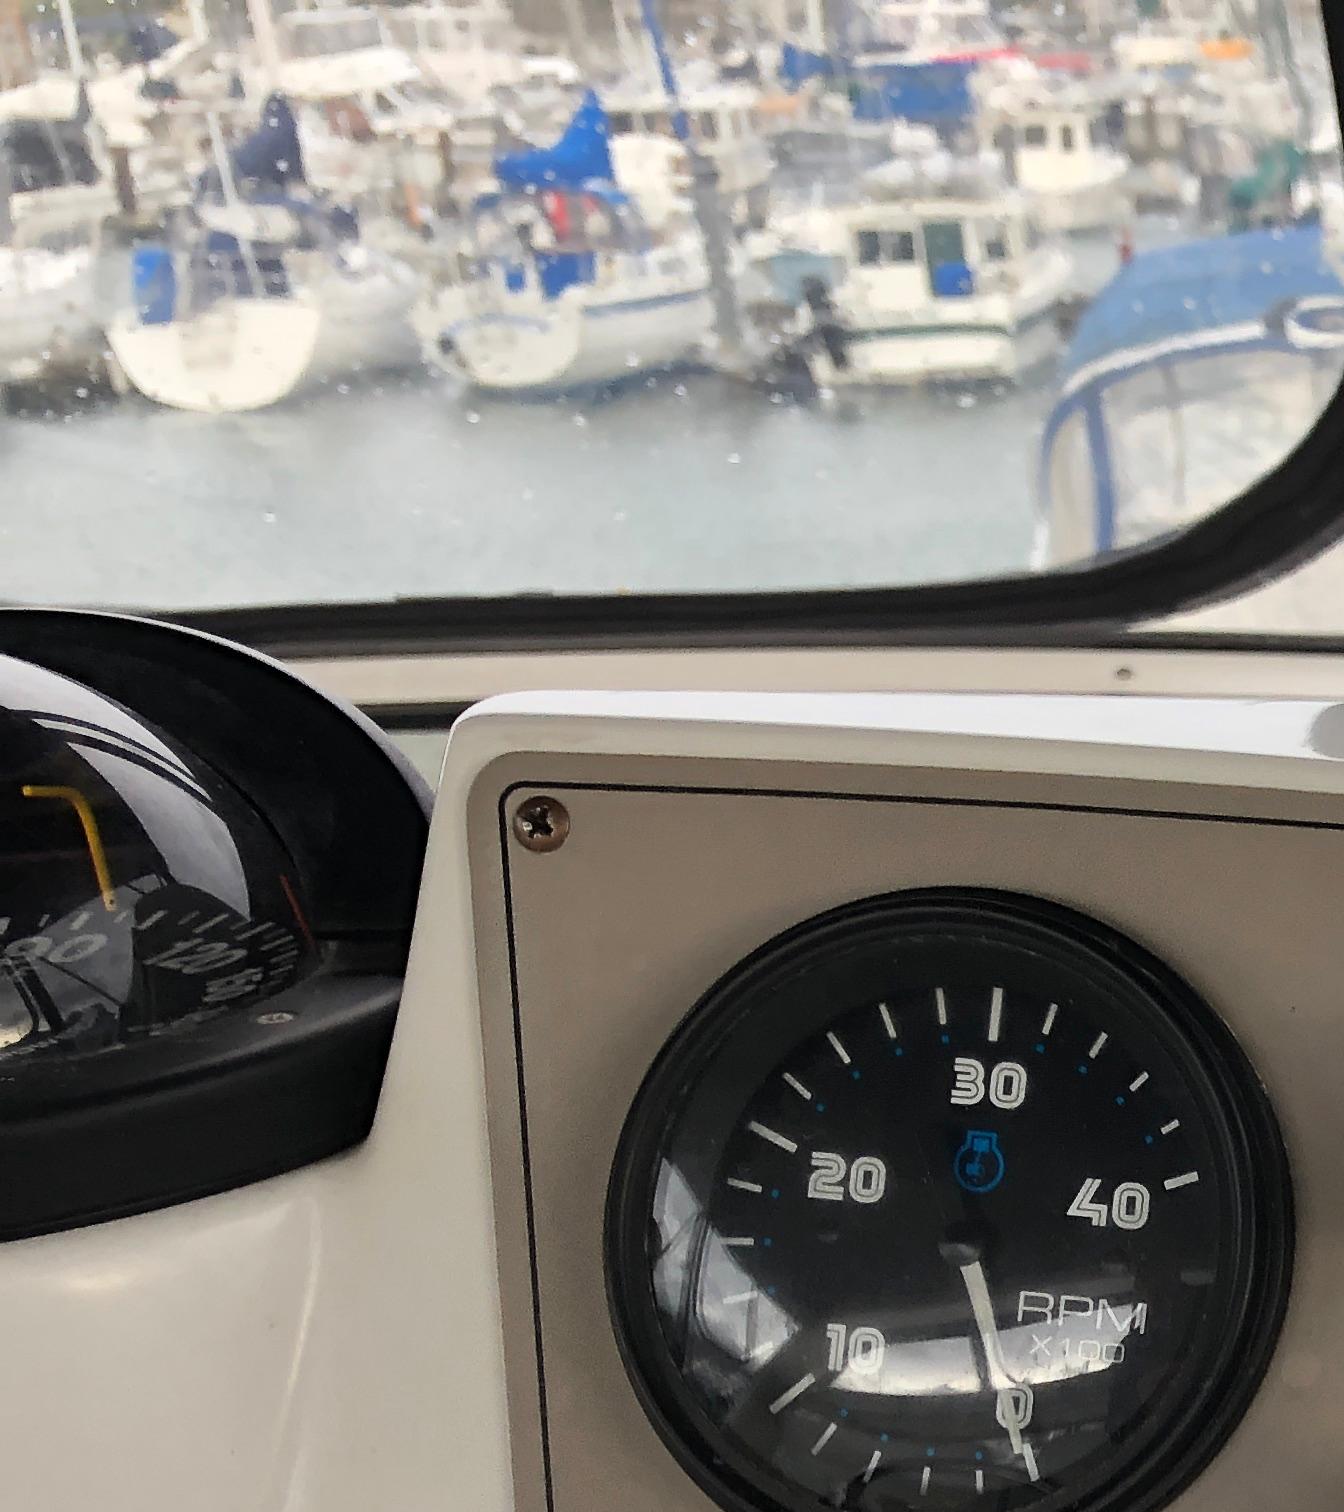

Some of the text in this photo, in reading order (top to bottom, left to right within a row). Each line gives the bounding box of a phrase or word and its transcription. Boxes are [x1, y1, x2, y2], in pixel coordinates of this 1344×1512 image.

[950, 1057, 1026, 1109] 30
[808, 1151, 886, 1204] 20
[1067, 1178, 1150, 1230] 40
[1017, 1290, 1148, 1336] RPM
[827, 1323, 886, 1374] 10
